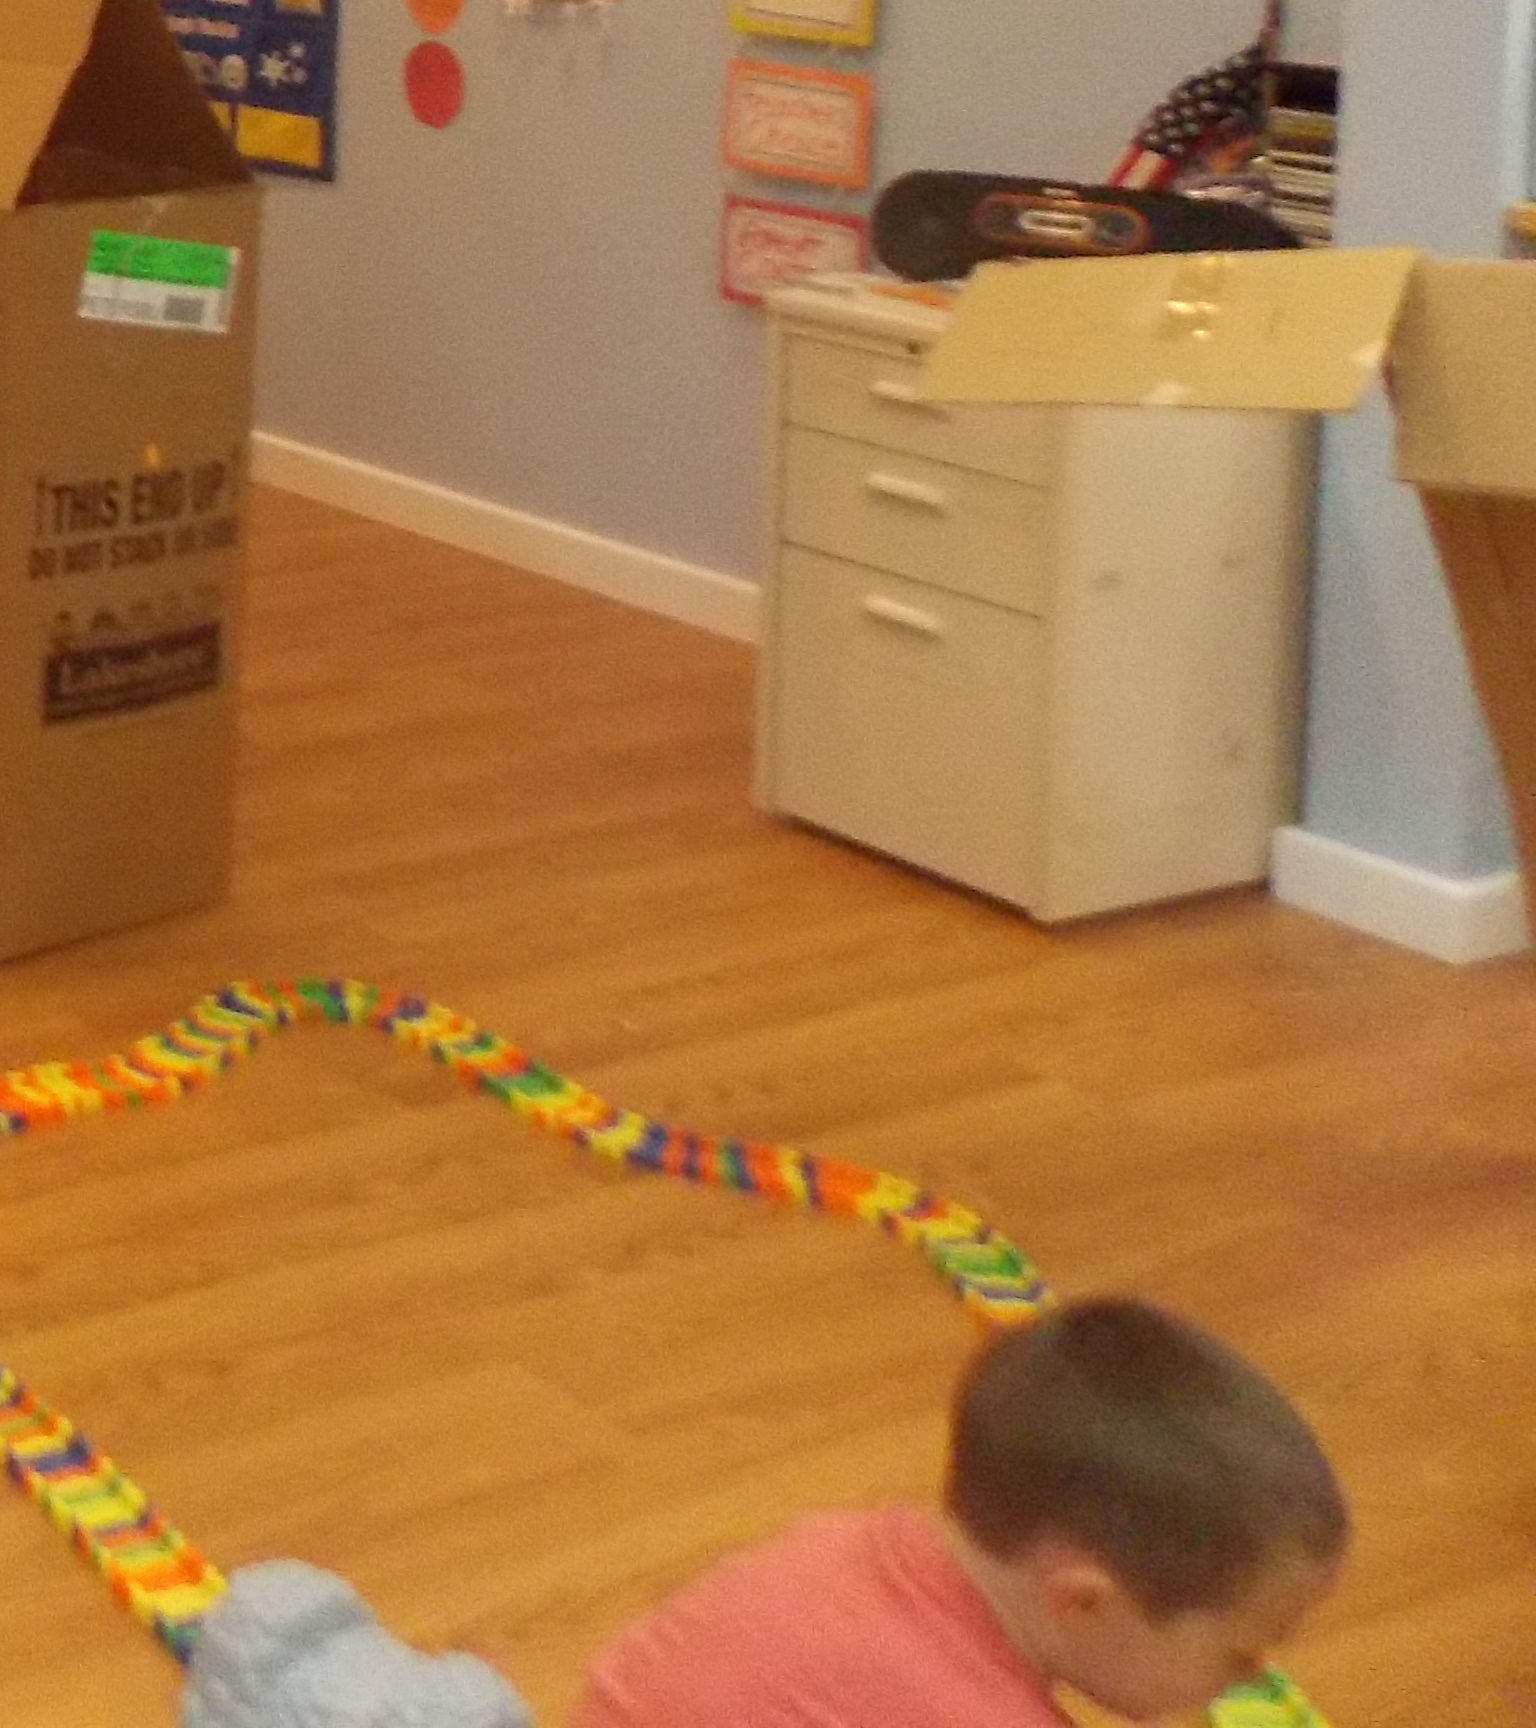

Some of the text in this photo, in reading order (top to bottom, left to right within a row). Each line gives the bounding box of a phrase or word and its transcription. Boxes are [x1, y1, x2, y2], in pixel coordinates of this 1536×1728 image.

[50, 458, 228, 536] THIS END UP
